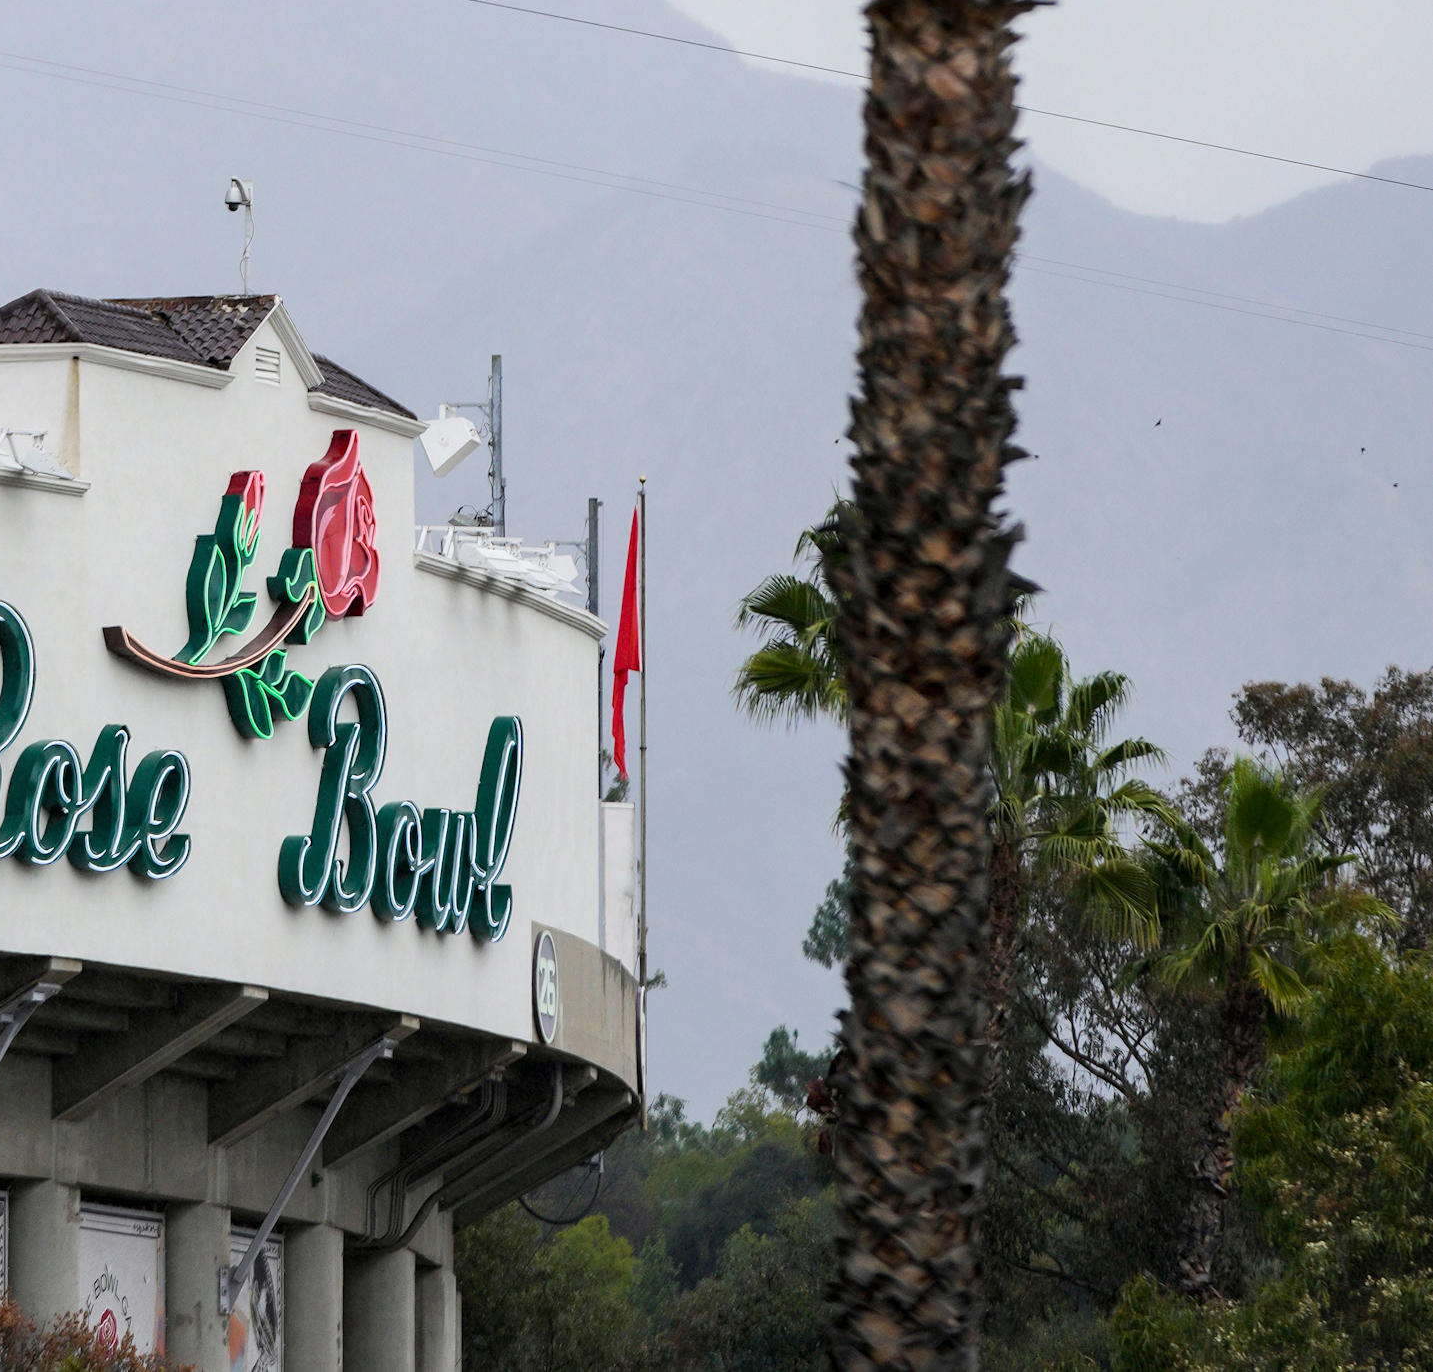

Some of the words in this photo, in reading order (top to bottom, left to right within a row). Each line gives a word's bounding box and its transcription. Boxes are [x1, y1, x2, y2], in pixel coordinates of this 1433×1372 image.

[278, 664, 522, 943] Bowl
[538, 957, 556, 1017] 26
[93, 1264, 121, 1302] BOWL
